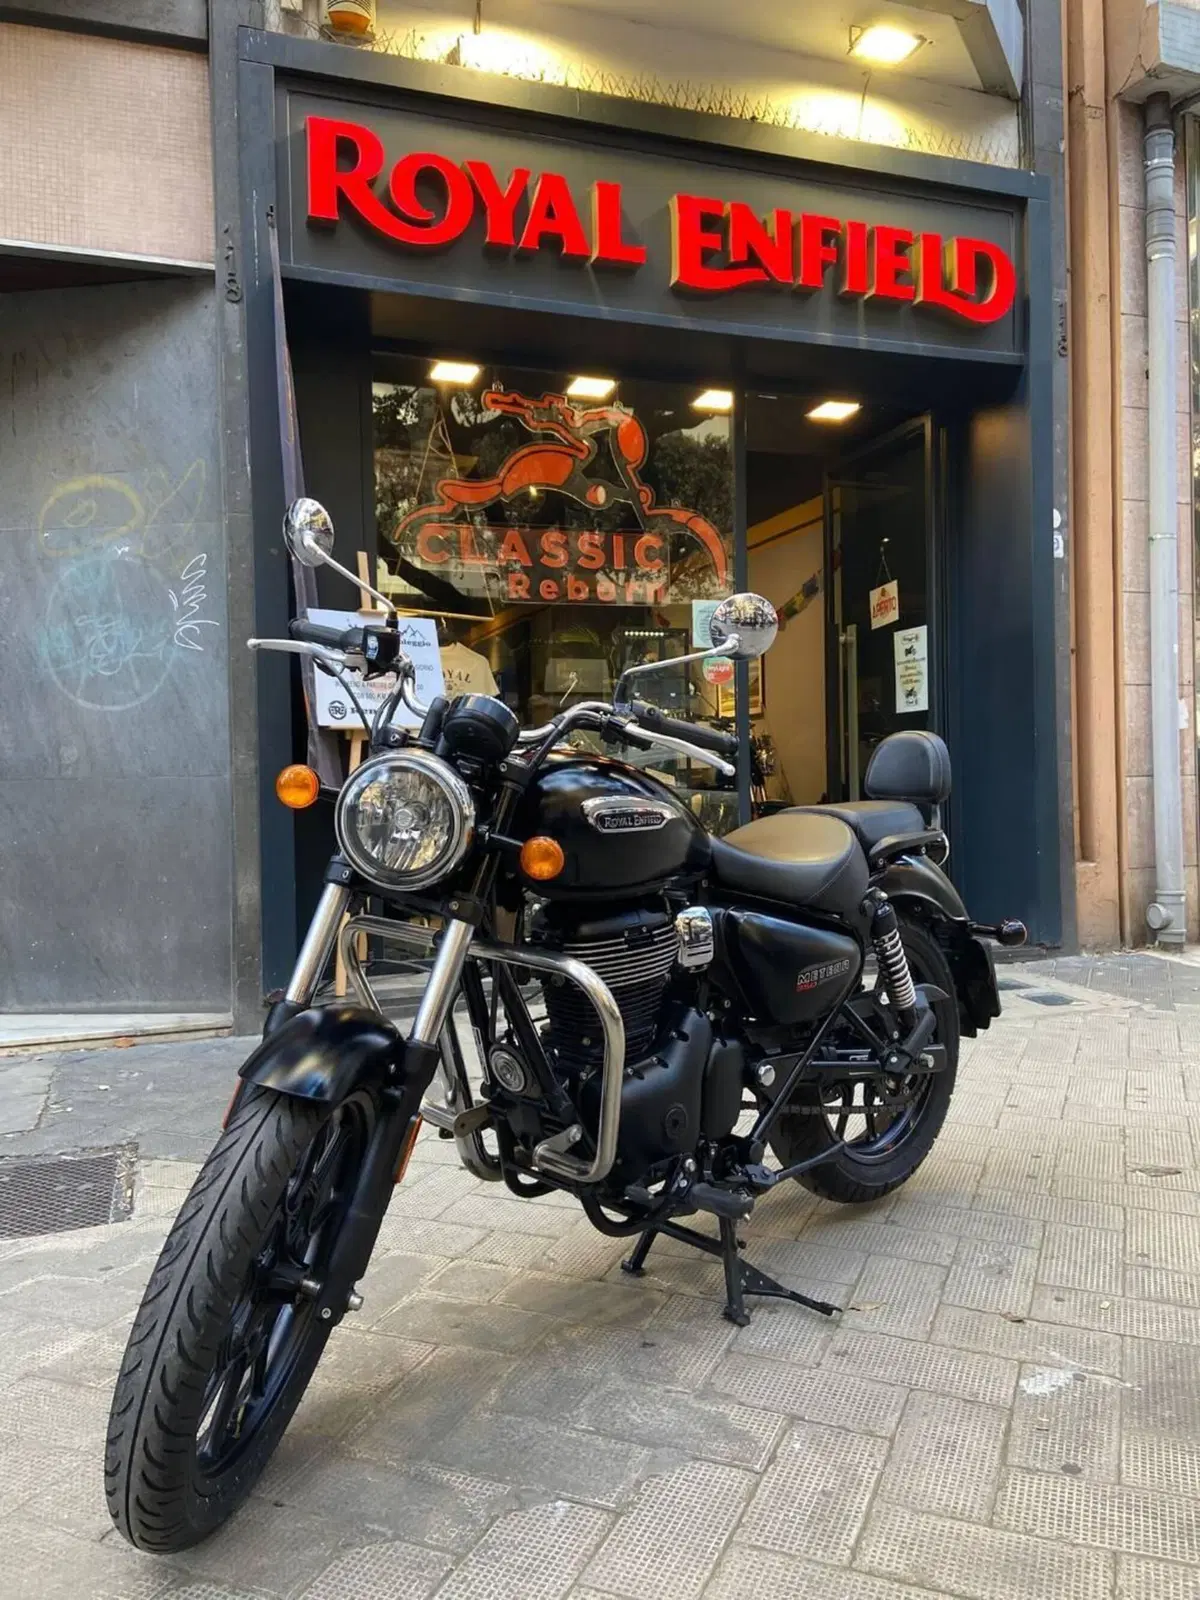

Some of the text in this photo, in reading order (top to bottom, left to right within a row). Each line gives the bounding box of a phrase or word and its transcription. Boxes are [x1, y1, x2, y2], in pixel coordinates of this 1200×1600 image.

[306, 116, 1018, 326] ROYAL ENFIELD
[415, 522, 665, 572] CLASSIC
[507, 573, 665, 603] Reborn
[604, 814, 662, 828] ROYAL ENFIELD
[796, 959, 850, 986] METEOR
